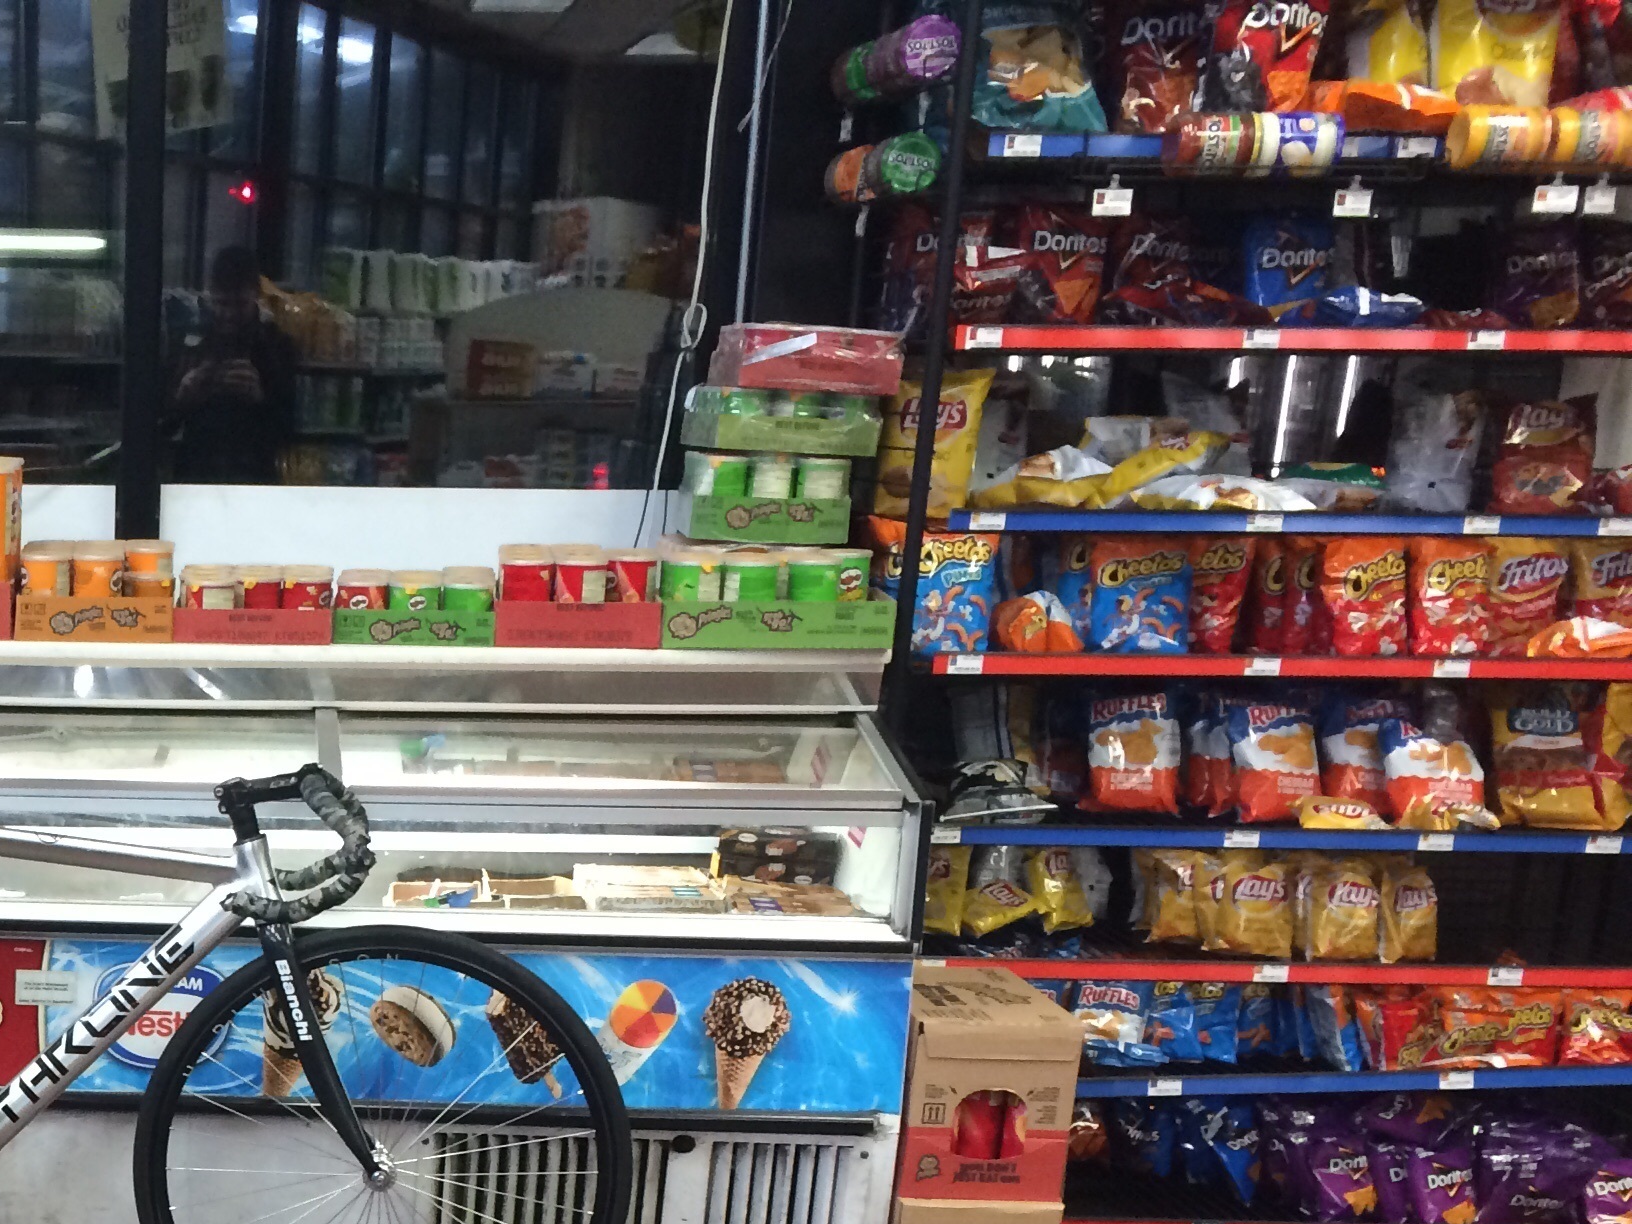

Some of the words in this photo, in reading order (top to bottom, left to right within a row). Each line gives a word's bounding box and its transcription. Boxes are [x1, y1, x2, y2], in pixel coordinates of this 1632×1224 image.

[1034, 230, 1109, 254] Doritos
[1097, 552, 1187, 587] Cheetos
[1498, 555, 1569, 592] Fritos
[274, 959, 313, 1042] Bianchi
[1080, 985, 1140, 1010] RUFFLES
